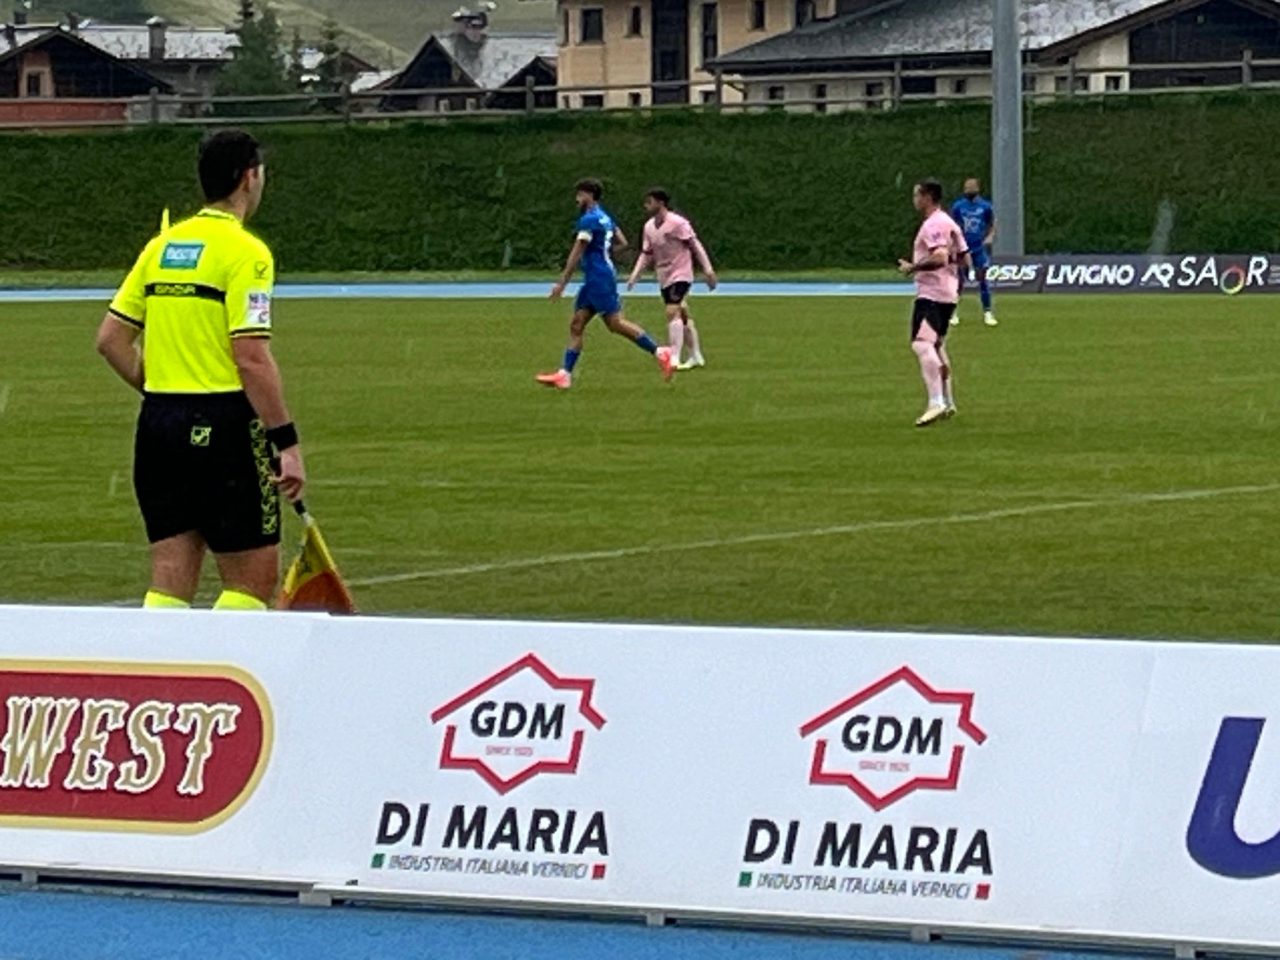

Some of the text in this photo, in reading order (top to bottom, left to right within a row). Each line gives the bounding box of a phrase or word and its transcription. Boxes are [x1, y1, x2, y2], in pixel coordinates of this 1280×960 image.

[1046, 264, 1135, 286] LIVIGNO
[470, 700, 566, 740] GDM
[842, 714, 943, 756] GDM
[0, 696, 241, 796] WEST
[376, 801, 610, 856] DI MARIA
[743, 818, 994, 876] DI MARIA
[389, 854, 463, 873] INDUSTRIA
[464, 857, 529, 877] ITALIANA
[757, 871, 971, 900] INDUSTRIA ITALIANA VERNICI
